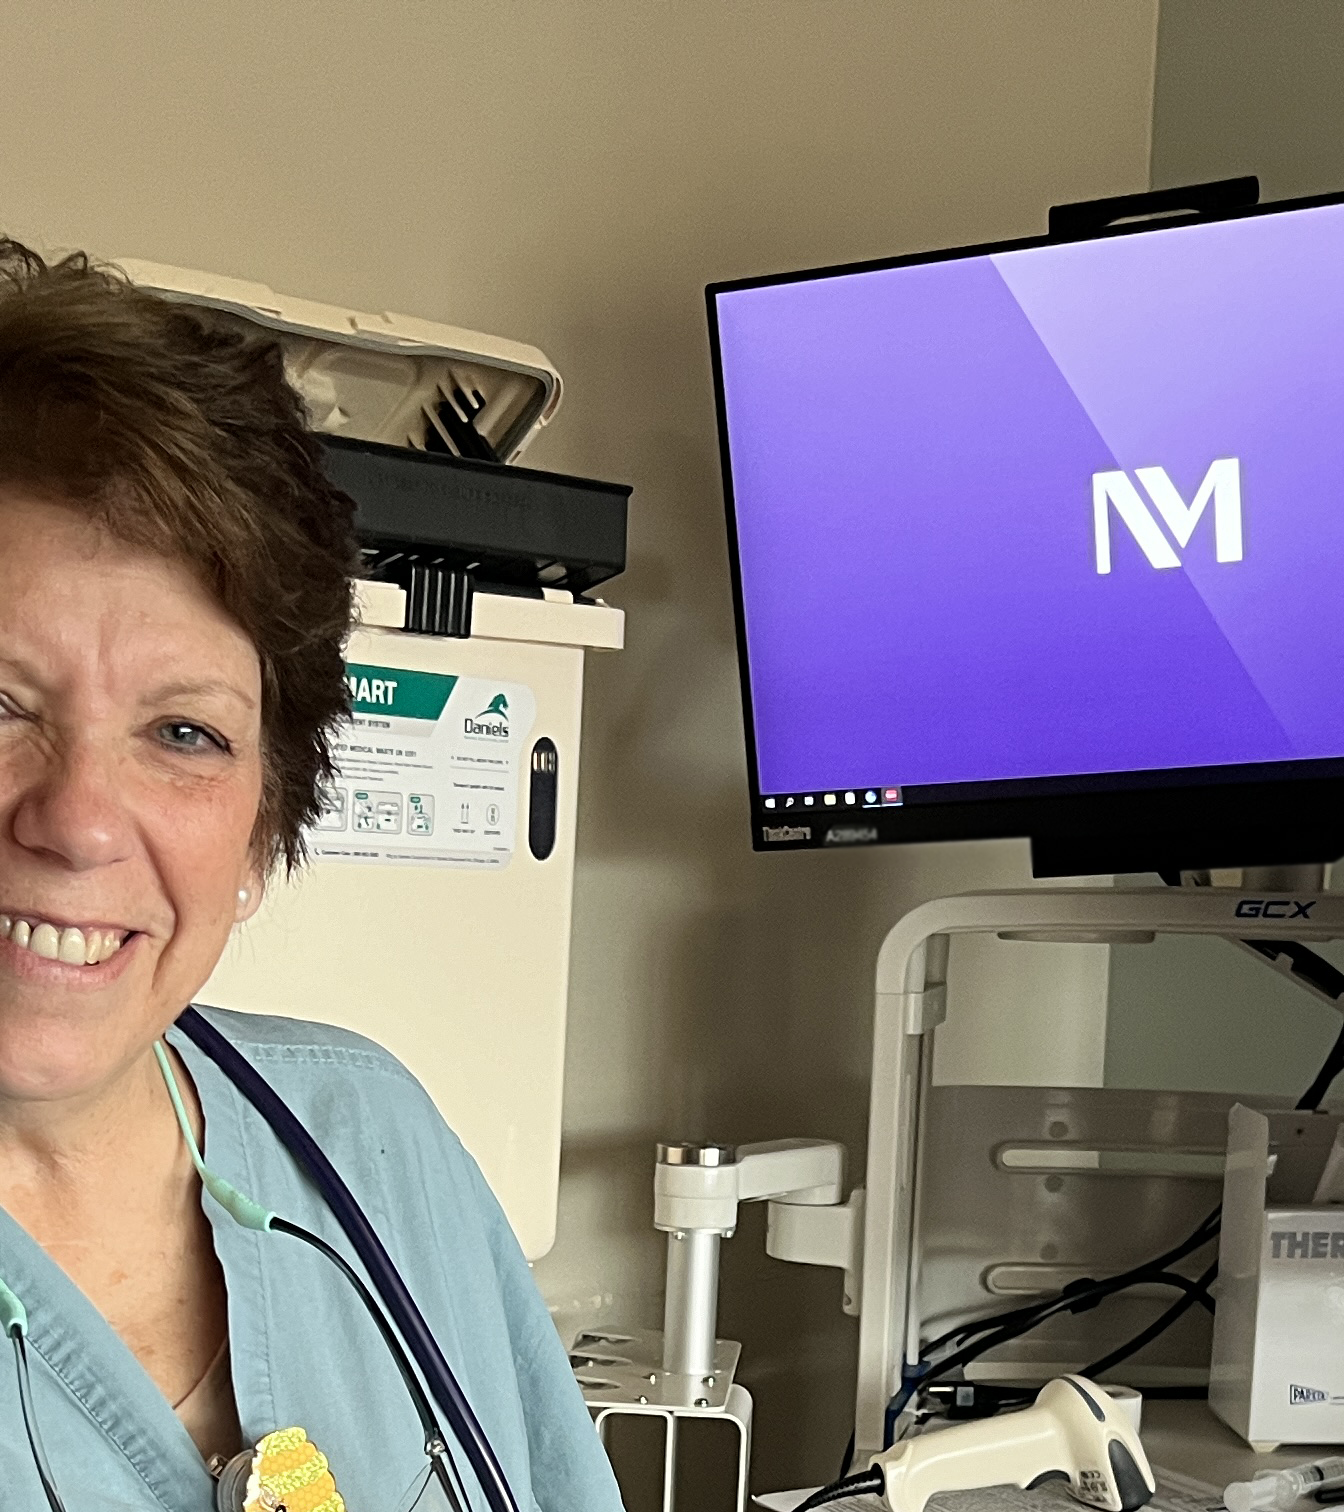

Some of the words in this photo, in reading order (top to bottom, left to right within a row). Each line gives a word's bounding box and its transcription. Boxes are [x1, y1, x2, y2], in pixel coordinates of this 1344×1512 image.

[1092, 457, 1243, 575] NM
[345, 676, 397, 705] MART
[464, 718, 509, 737] Daniels
[1235, 900, 1316, 919] GCX
